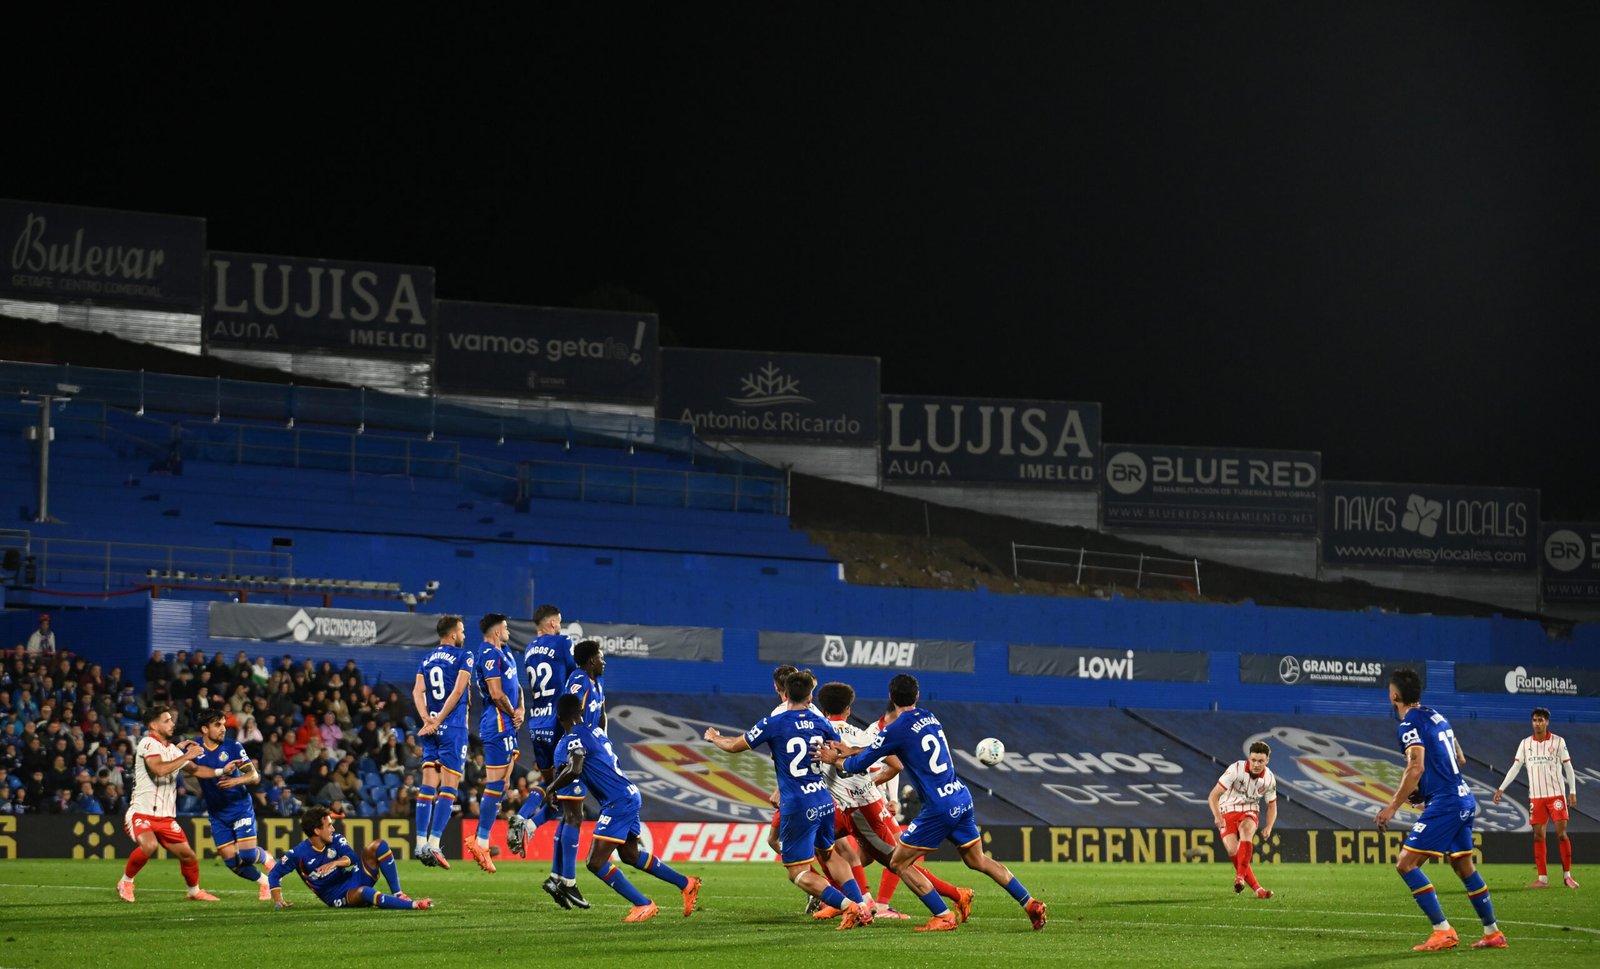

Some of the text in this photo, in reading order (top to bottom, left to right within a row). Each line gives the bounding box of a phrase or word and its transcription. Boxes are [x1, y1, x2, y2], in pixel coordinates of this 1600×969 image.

[12, 212, 165, 280] Bulevar
[213, 260, 427, 326] LUJISA
[213, 321, 426, 349] AUNA IMELCO
[448, 332, 540, 355] vamos
[680, 407, 759, 432] Antonio
[780, 413, 861, 435] Ricardo
[887, 402, 1094, 459] LUJISA
[887, 460, 1094, 481] AUNA IMELCO
[1112, 463, 1142, 483] BR
[1152, 456, 1317, 488] BLUE RED
[1334, 495, 1397, 532] NAVES
[1446, 500, 1527, 537] LOCALES
[1334, 545, 1527, 563] www.navesylocales.com
[1550, 542, 1581, 559] BR
[314, 617, 377, 639] TECNOCASA
[850, 640, 917, 668] MAPEI
[1302, 660, 1382, 676] GRAND CLASS
[429, 666, 446, 700] 9
[526, 661, 556, 700] 22
[795, 719, 815, 730] LISO
[461, 745, 468, 759] 9
[502, 735, 514, 752] 16
[921, 729, 955, 775] 21
[1042, 783, 1210, 806] DE FE
[1020, 827, 1215, 864] LEGENDS
